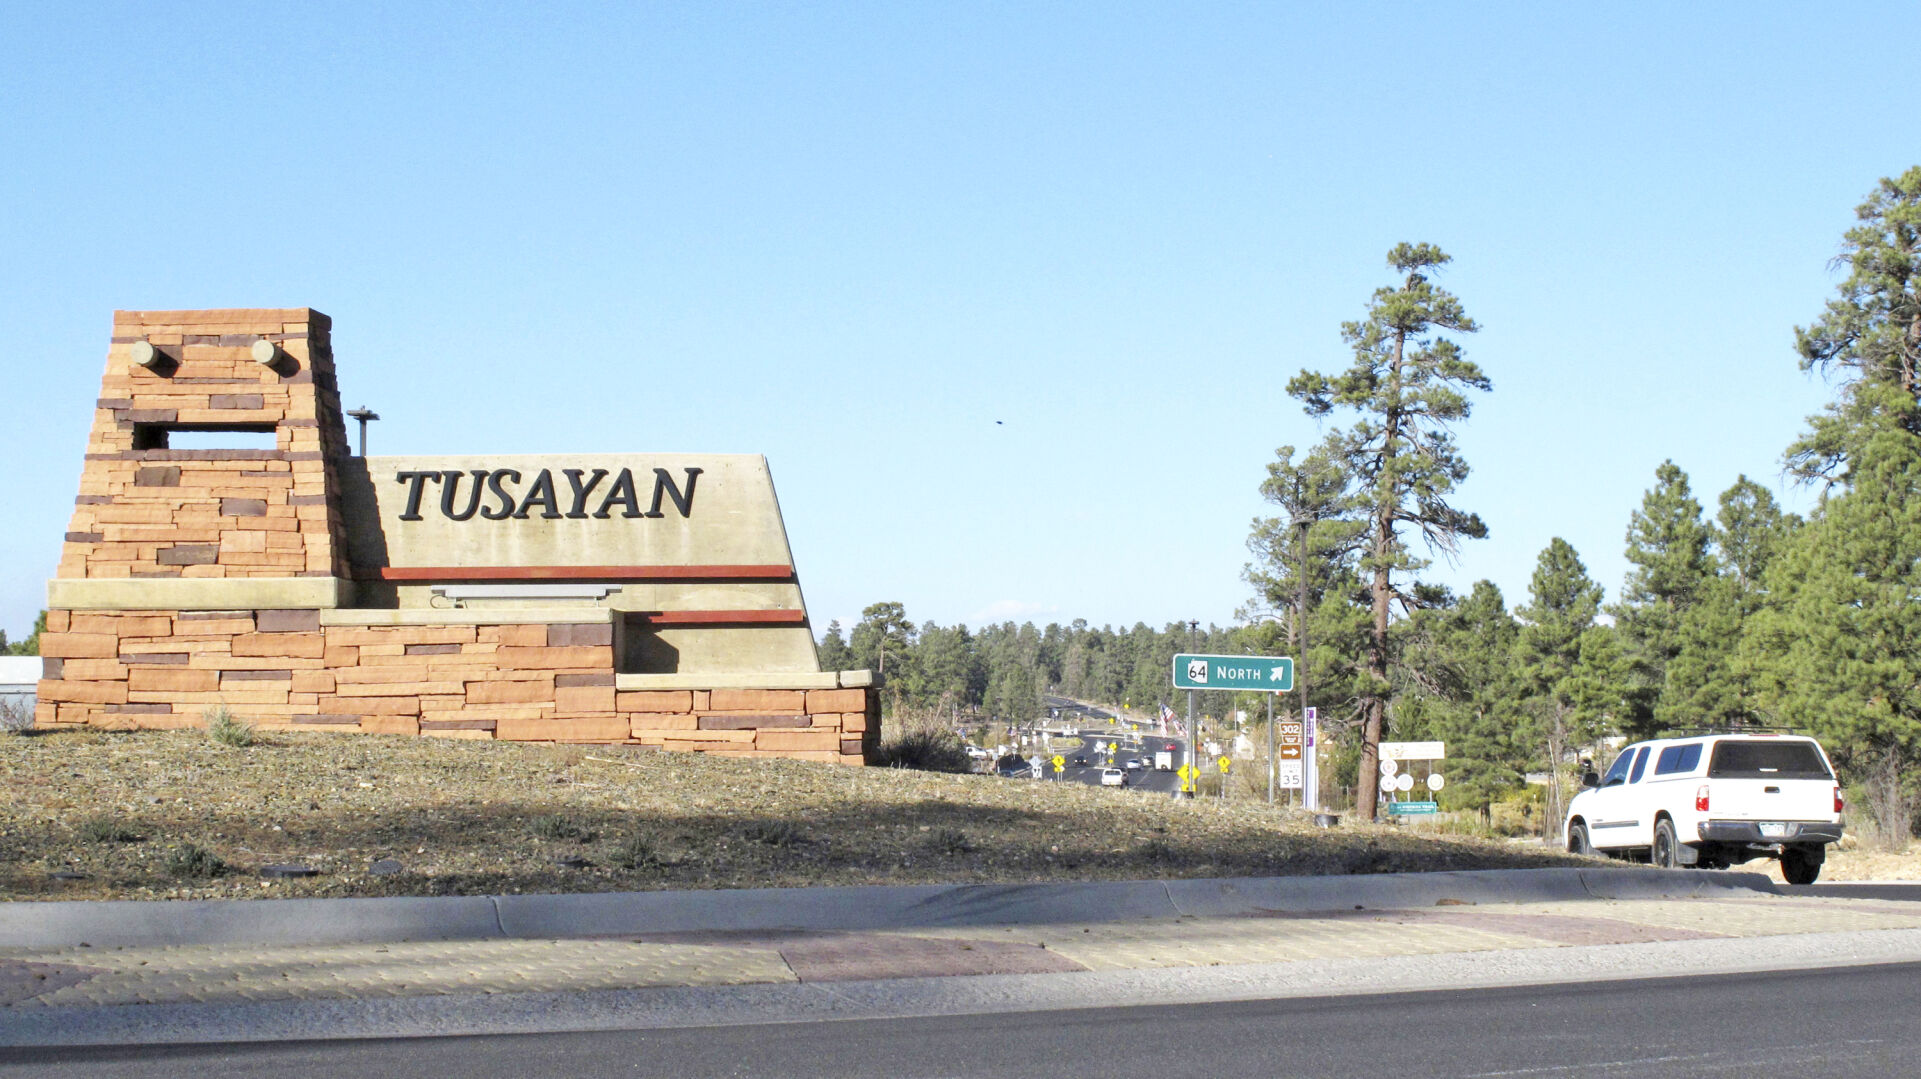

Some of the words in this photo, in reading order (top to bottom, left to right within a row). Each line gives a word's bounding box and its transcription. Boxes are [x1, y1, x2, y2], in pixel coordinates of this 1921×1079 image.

[397, 467, 704, 521] TUSAYAN
[1189, 665, 1206, 678] 64
[1217, 666, 1261, 680] NORTH
[1282, 725, 1300, 734] 302
[1283, 774, 1300, 785] 35
